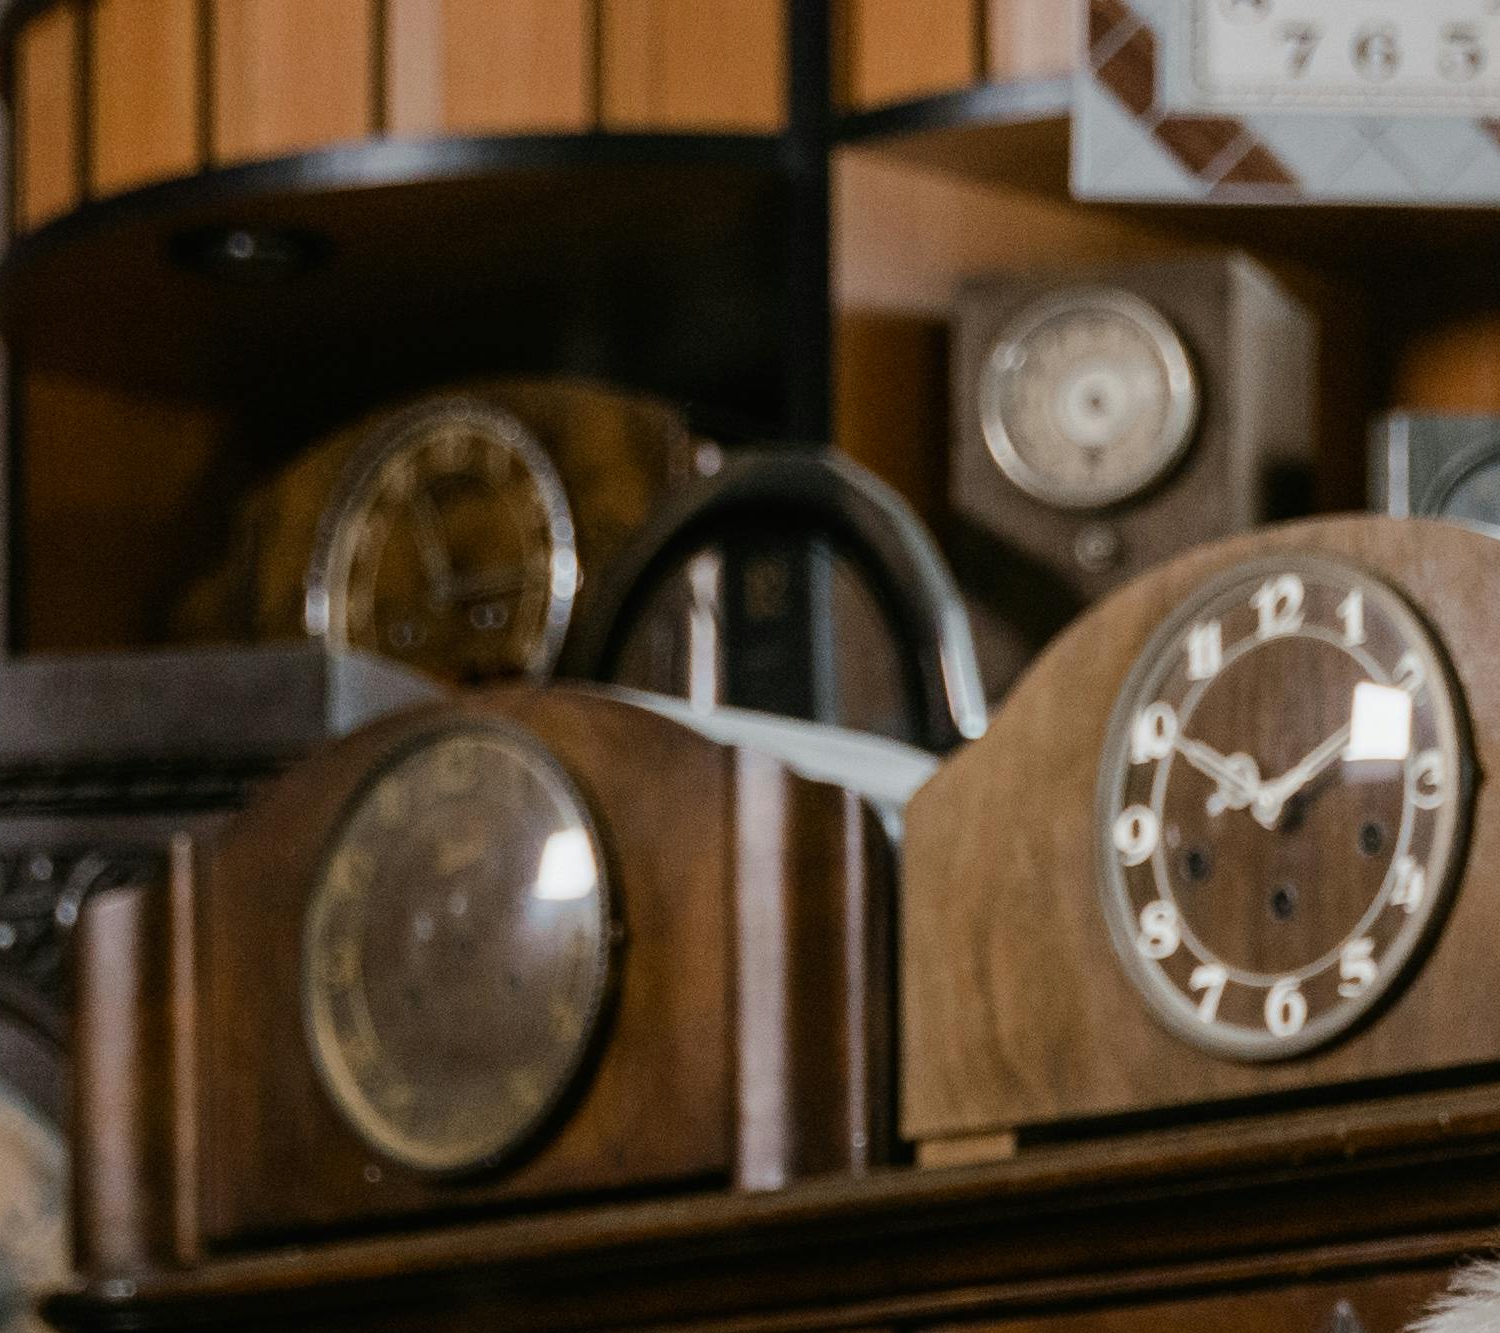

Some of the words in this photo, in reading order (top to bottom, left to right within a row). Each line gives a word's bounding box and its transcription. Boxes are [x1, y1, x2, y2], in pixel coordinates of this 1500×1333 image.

[1279, 18, 1323, 80] 7
[1348, 19, 1398, 83] 6
[1434, 19, 1487, 83] 5
[1250, 573, 1306, 637] 12
[1336, 588, 1366, 648] 1
[1130, 700, 1179, 765] 10
[1411, 749, 1444, 811] 3
[1113, 803, 1160, 868] 9
[1138, 898, 1181, 961] 8
[1189, 962, 1229, 1025] 7
[1338, 935, 1380, 999] 5
[1263, 979, 1309, 1039] 6
